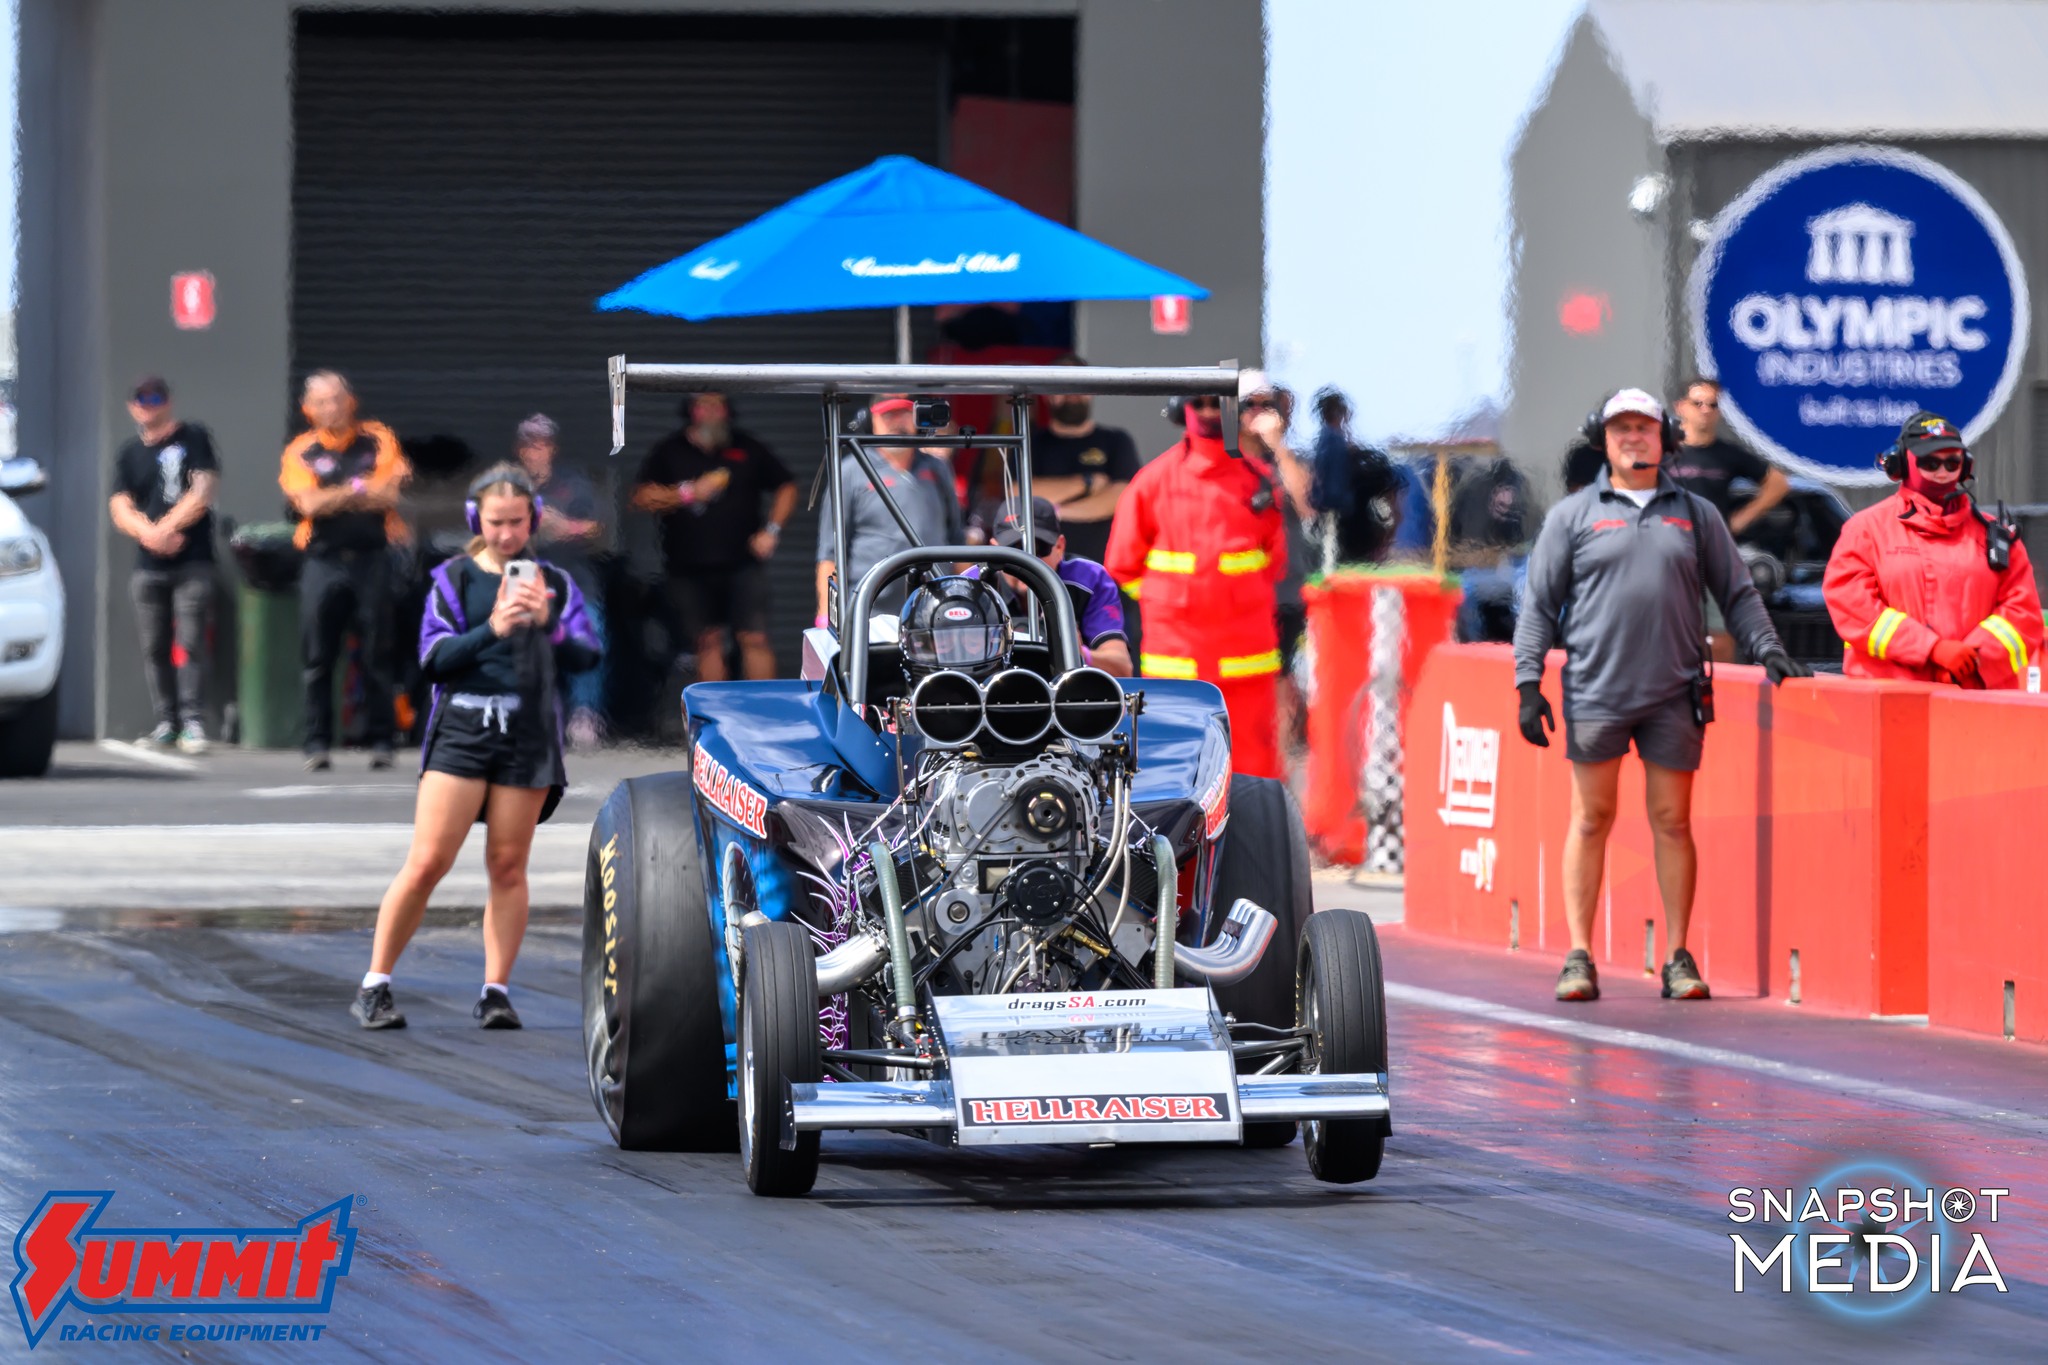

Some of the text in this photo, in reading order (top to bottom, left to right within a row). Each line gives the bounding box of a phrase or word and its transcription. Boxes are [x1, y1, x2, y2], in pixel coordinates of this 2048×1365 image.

[1729, 293, 1989, 351] OLYMPIC
[694, 742, 767, 839] HELLRAISER
[1008, 996, 1146, 1011] dragsSA.com
[970, 1096, 1221, 1124] HELLRAISER
